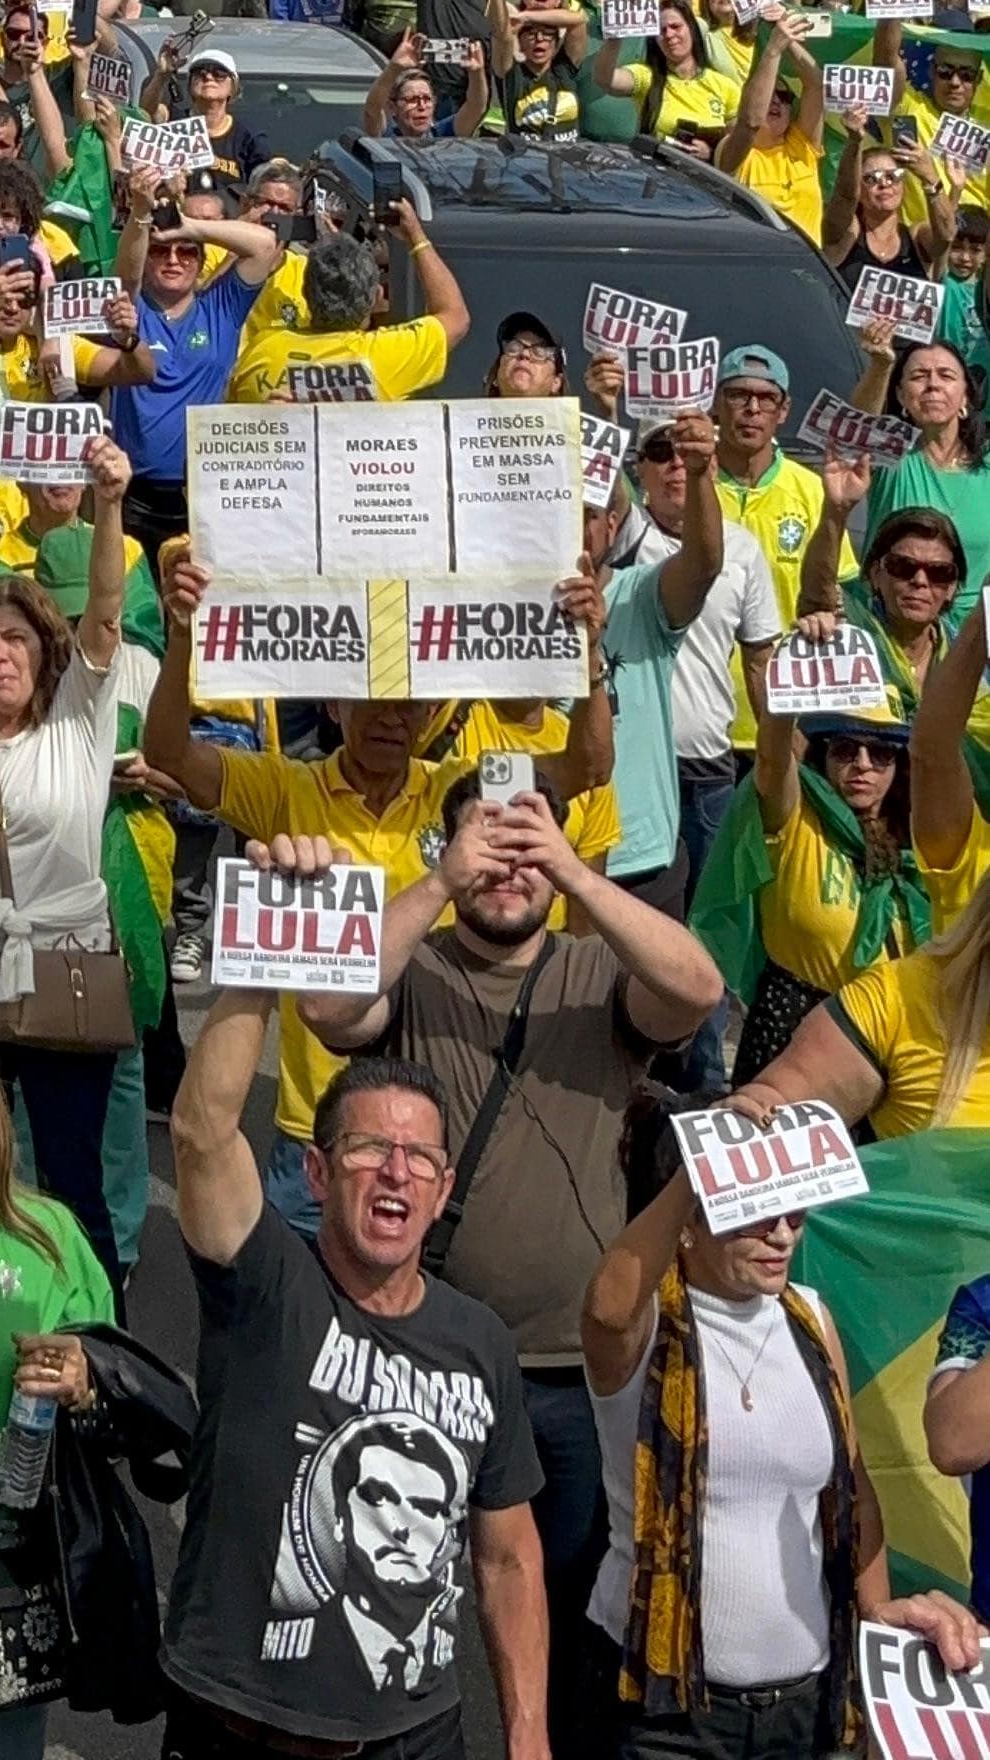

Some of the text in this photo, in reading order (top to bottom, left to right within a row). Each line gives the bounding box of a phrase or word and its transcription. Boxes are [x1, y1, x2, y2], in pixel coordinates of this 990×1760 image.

[604, 10, 658, 26] LULA
[91, 55, 129, 77] FORA
[826, 66, 890, 86] FORA
[89, 71, 127, 97] LULA
[825, 83, 890, 103] LULA
[126, 120, 193, 152] FORA
[48, 280, 118, 302] FORA
[861, 271, 939, 308] FORA
[592, 287, 678, 336] FORA
[853, 289, 935, 326] LULA
[627, 341, 716, 372] FORA
[287, 363, 371, 390] FORA
[628, 367, 714, 400] LULA
[3, 407, 101, 435] FORA
[211, 420, 289, 435] DECISÕES
[477, 413, 544, 430] PRISÕES
[195, 440, 306, 455] JUDICIAIS SEM
[346, 438, 418, 452] MORAES
[459, 434, 566, 449] PREVENTIVAS
[202, 458, 304, 472] CONTRADITÓRIO
[349, 462, 415, 475] VIOLOU
[472, 453, 554, 468] EM MASSA
[220, 478, 287, 490] E AMPLA
[356, 483, 410, 492] DIREITOS
[497, 473, 530, 485] SEM
[220, 496, 282, 509] DEFESA
[354, 499, 412, 508] HUMANOS
[458, 488, 572, 502] FUNDAMENTAÇÃO
[338, 514, 429, 523] FUNDAMENTAIS
[242, 639, 365, 663] MORAES
[459, 637, 582, 662] MORAES
[770, 656, 879, 688] LULA
[224, 864, 378, 913] FORA
[221, 906, 376, 956] LULA
[679, 1102, 835, 1155] FORA
[693, 1123, 852, 1197] LULA
[292, 1476, 303, 1532] HOMEM
[294, 1534, 306, 1555] DE
[260, 1617, 315, 1661] MITO
